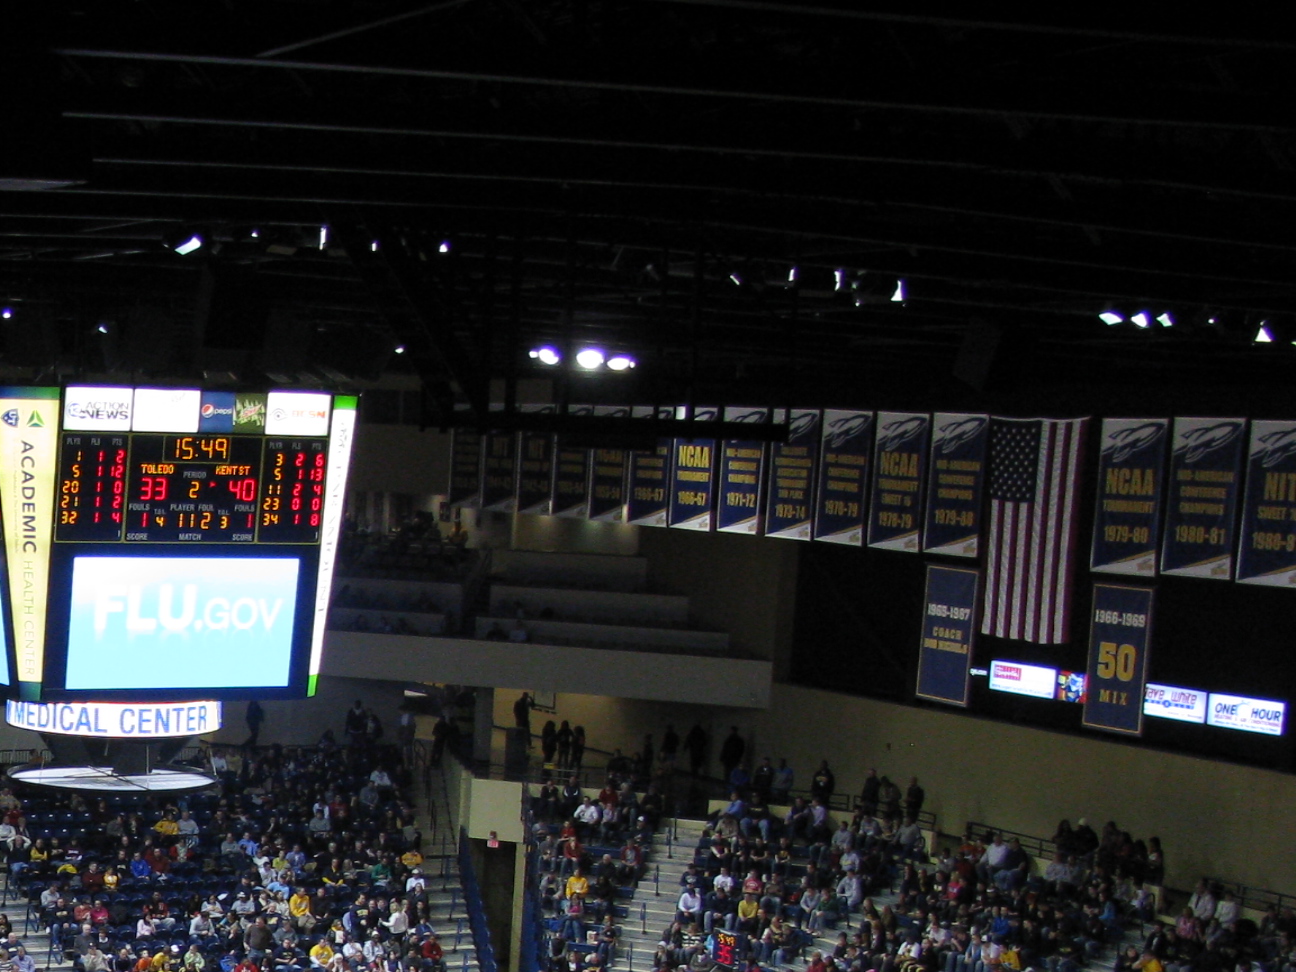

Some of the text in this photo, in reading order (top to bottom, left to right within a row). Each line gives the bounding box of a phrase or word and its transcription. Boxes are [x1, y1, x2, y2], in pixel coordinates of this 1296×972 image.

[86, 401, 129, 411] ACTION
[84, 409, 129, 420] NEWS
[175, 437, 228, 460] 15:49
[116, 450, 125, 463] 2
[276, 453, 323, 467] 3 2 6
[678, 445, 710, 468] NCAA
[140, 464, 175, 475] TOLEDO
[880, 451, 919, 477] NCAA
[72, 465, 80, 477] 5
[111, 465, 124, 478] 12
[183, 471, 207, 479] PERIOD
[274, 468, 282, 480] 5
[310, 469, 323, 481] 13
[62, 481, 80, 493] 20
[114, 481, 123, 494] 0
[1104, 467, 1155, 496] NCAA
[1264, 471, 1296, 502] NIT
[140, 478, 255, 501] 33 2 40
[268, 483, 322, 496] 11 2 4
[61, 496, 79, 508] 21
[112, 496, 121, 509] 2
[263, 498, 320, 511] 23 0 0
[726, 492, 757, 508] 1971-72
[129, 503, 151, 511] FOULS
[170, 503, 214, 512] PLAYER FOUL
[234, 504, 255, 512] FOULS
[61, 511, 78, 524] 32
[112, 512, 122, 523] 4
[155, 516, 164, 527] 4
[220, 516, 228, 529] 3
[263, 513, 279, 526] 34
[310, 513, 319, 526] 8
[126, 532, 253, 541] SCORE MATCH SCORE
[1104, 524, 1150, 543] 1979-80
[1175, 525, 1226, 545] 1980-81
[1252, 531, 1296, 552] 1980-8
[21, 440, 37, 675] ACADEMIC HEALTH CENTER
[94, 584, 282, 629] FLU.GOV
[1094, 608, 1146, 628] 1966-1969
[932, 625, 963, 641] COACH
[1097, 641, 1137, 682] 50
[1099, 688, 1127, 706] MIX
[1146, 687, 1165, 700] ave
[14, 701, 208, 734] MEDICAL CENTER
[1214, 702, 1236, 716] ONE
[1251, 708, 1281, 722] HOUR
